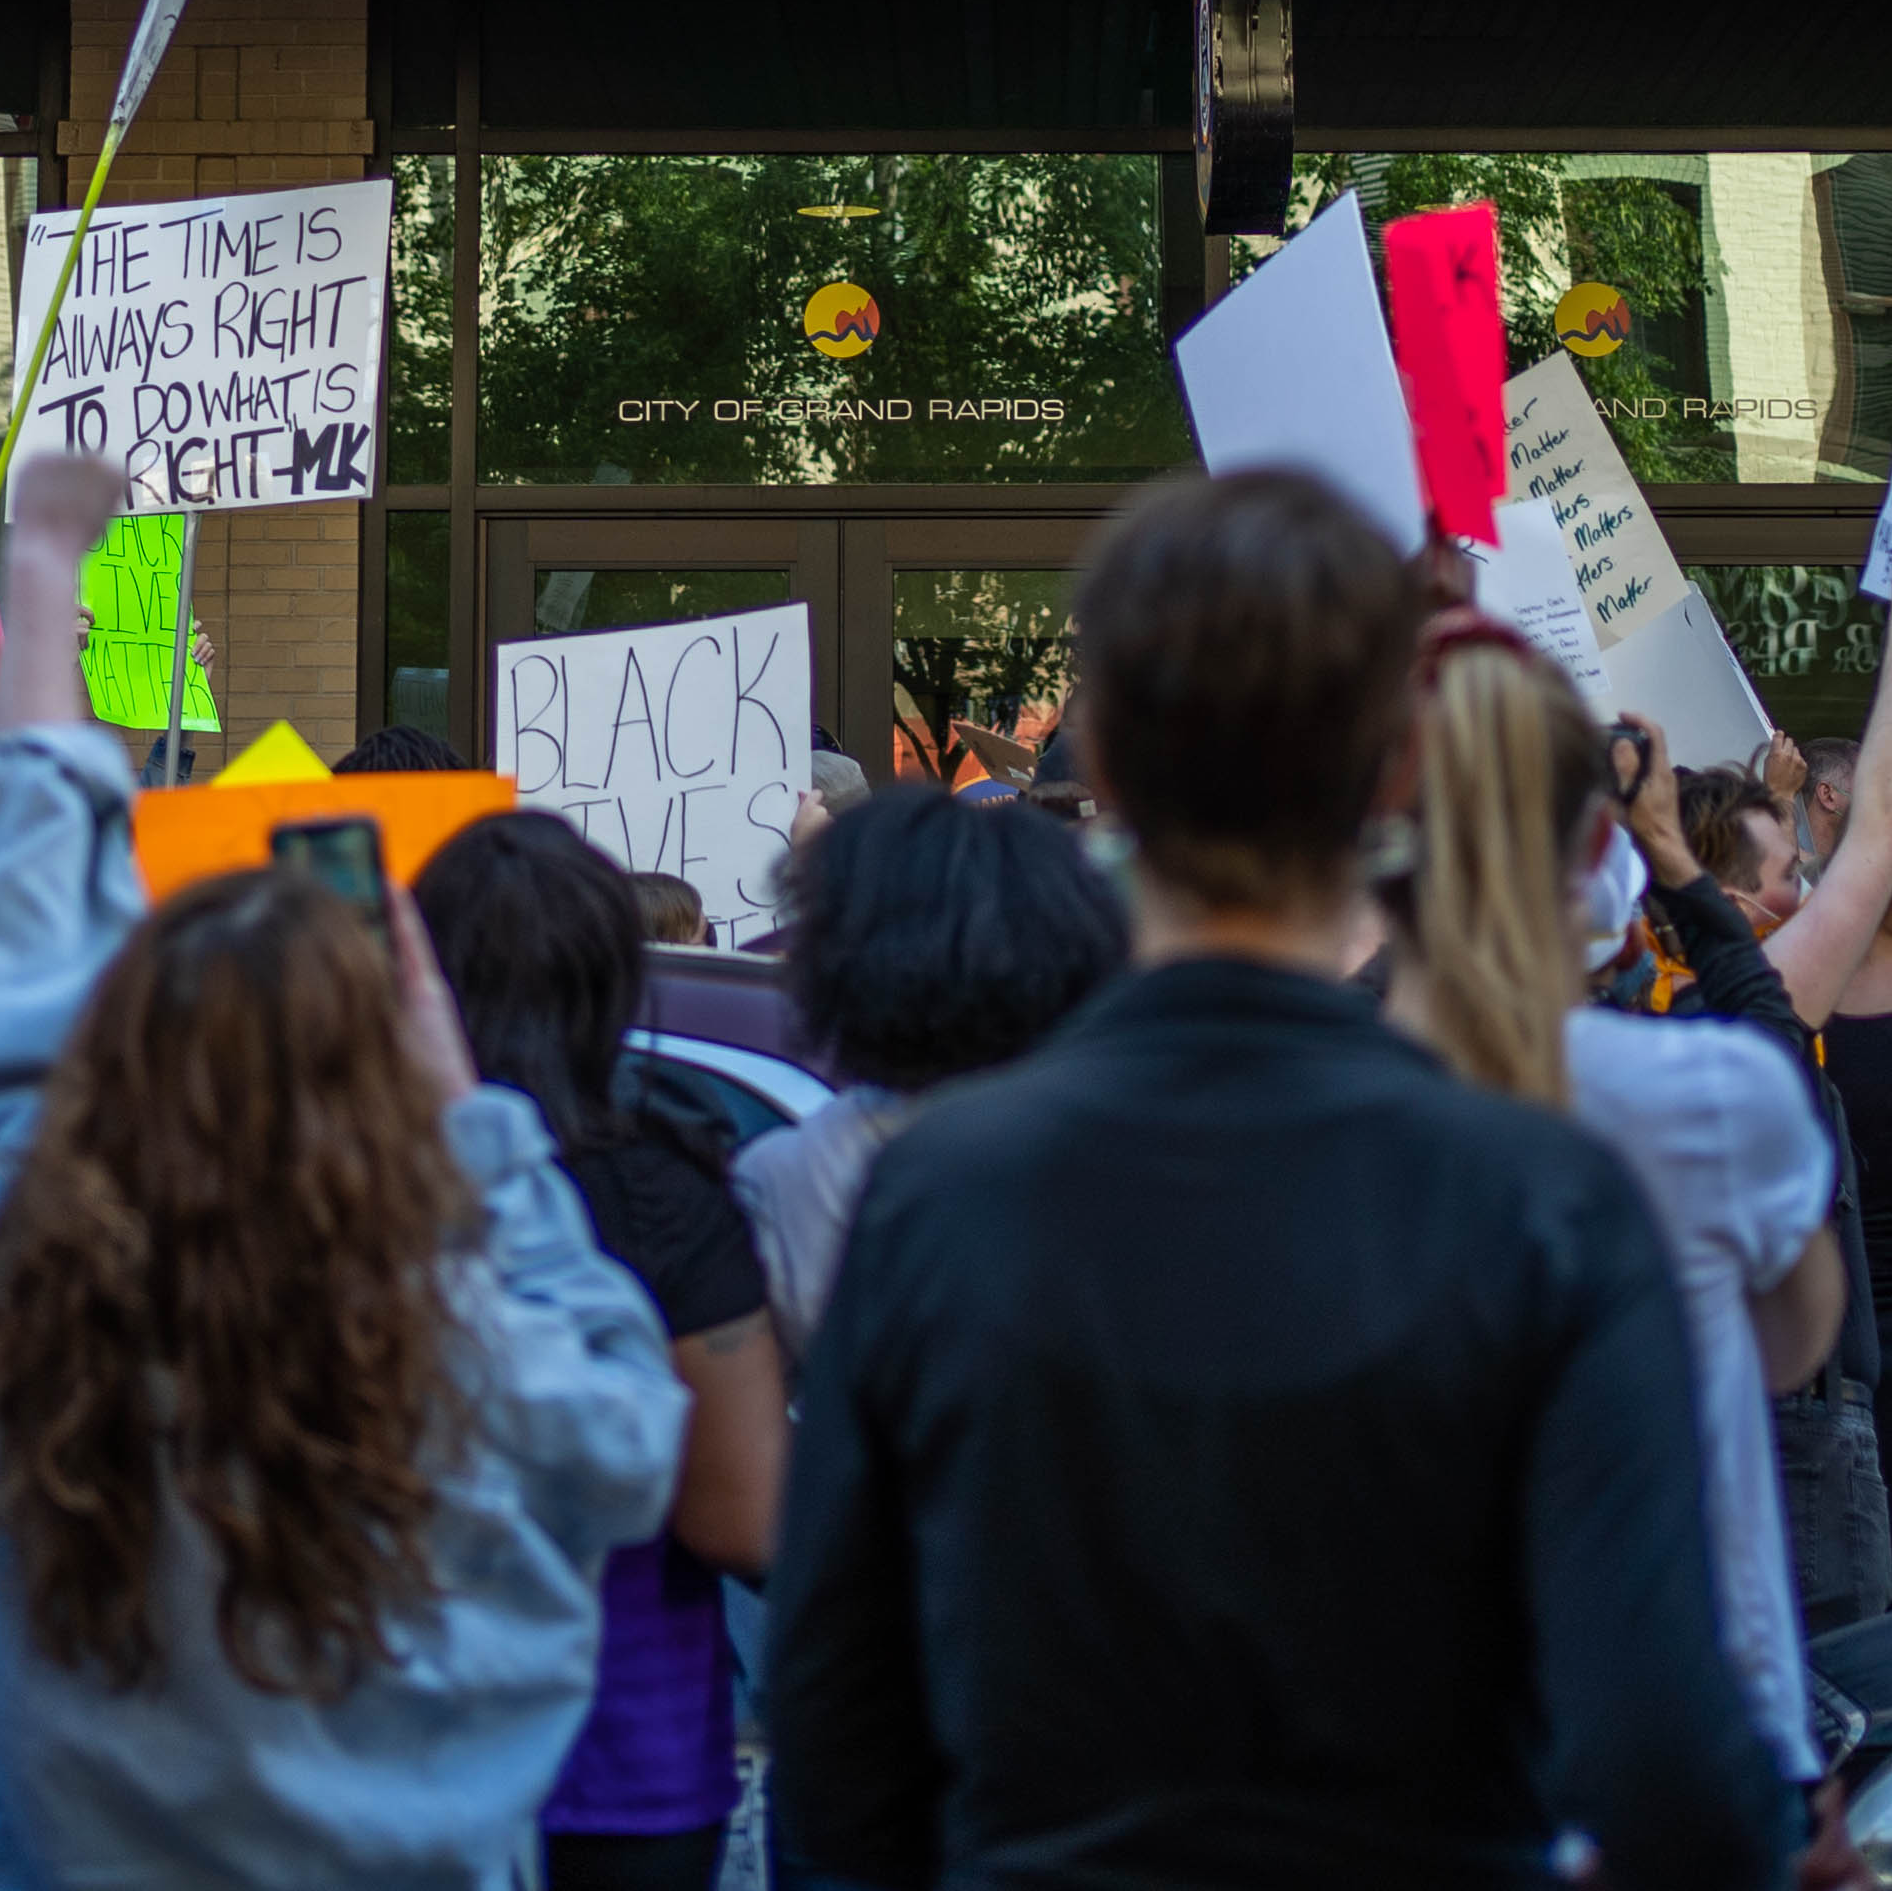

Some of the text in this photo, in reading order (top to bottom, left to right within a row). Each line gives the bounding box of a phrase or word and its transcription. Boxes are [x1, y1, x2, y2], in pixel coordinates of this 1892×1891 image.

[160, 208, 283, 278] TIME
[296, 207, 342, 264] IS
[215, 276, 367, 363] RIGHT
[38, 363, 358, 457] TO DO WHAT IS
[618, 398, 1065, 422] CITY OF GRAND RAPIDS
[1593, 397, 1818, 420] AND RAPIDS
[1597, 576, 1652, 624] Matter
[511, 626, 787, 793] BLACK
